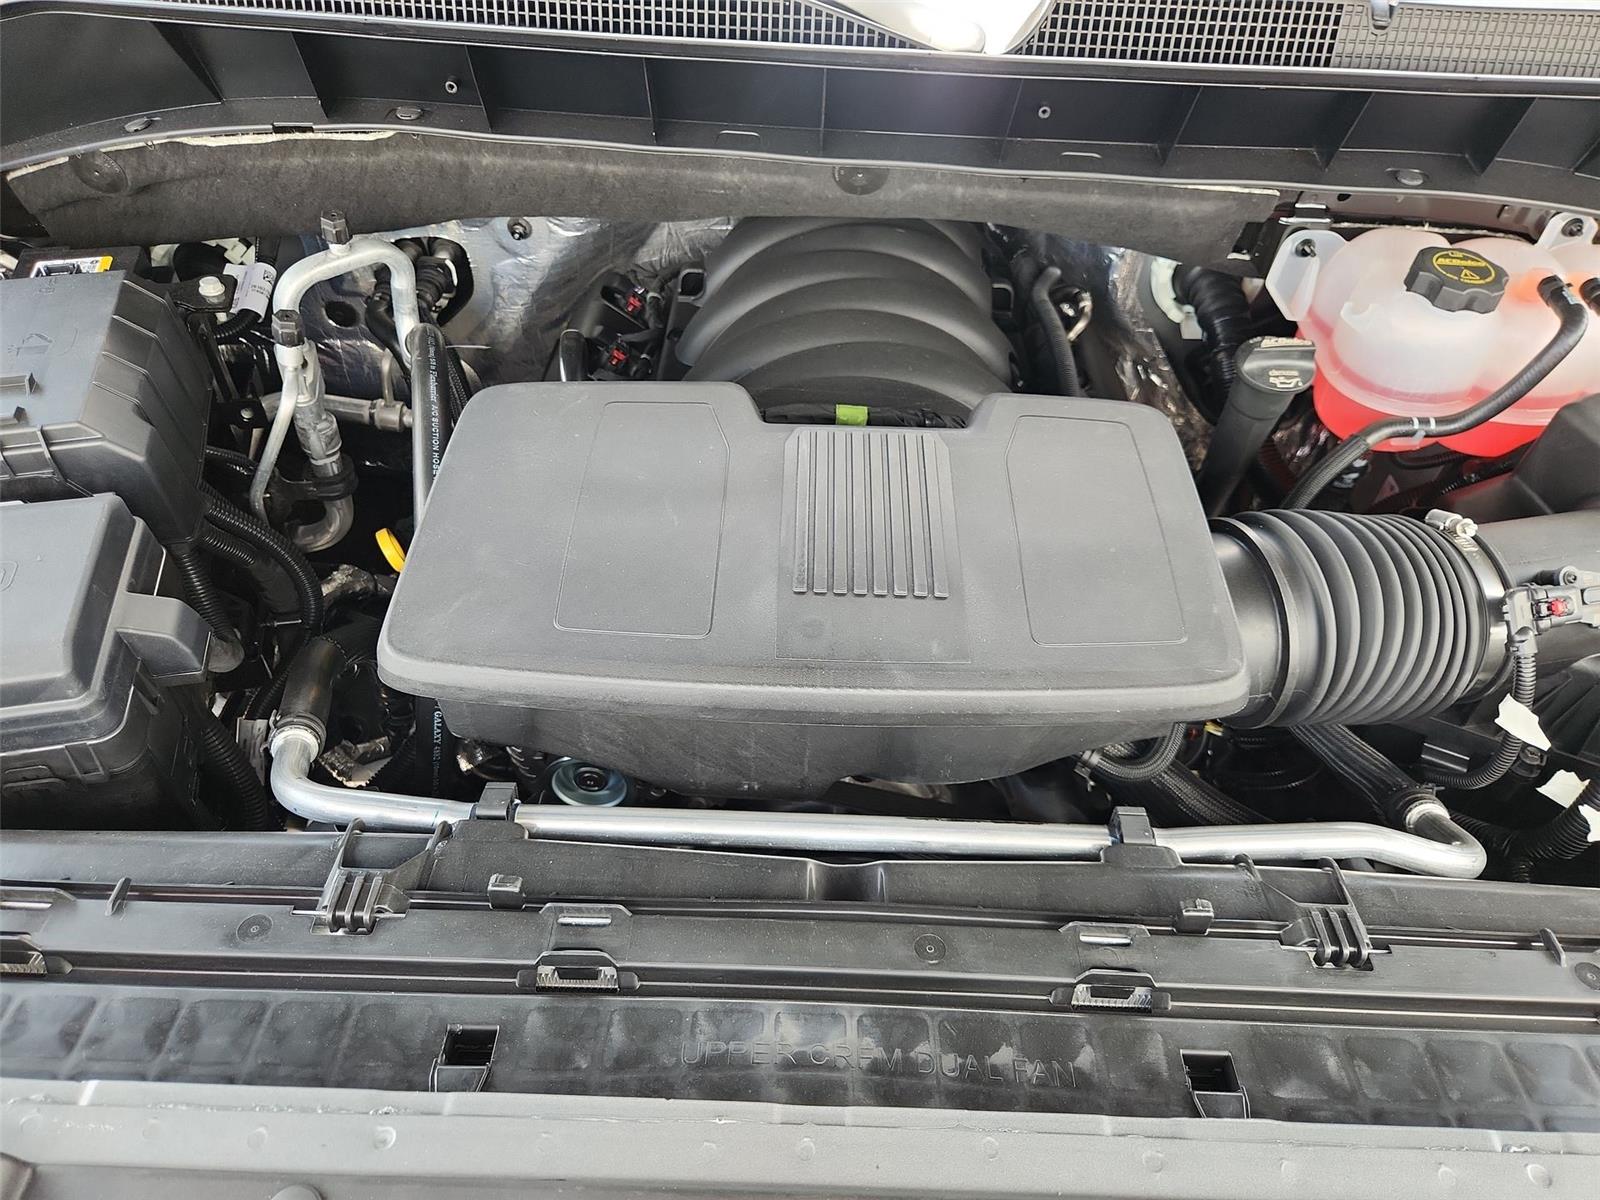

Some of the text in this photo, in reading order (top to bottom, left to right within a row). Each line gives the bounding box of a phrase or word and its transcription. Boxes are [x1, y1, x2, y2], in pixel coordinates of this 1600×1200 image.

[432, 417, 440, 450] SUCTION
[434, 711, 443, 744] GALAXY
[681, 1041, 797, 1065] UPPER
[917, 1052, 1003, 1082] DUAL
[1012, 1057, 1077, 1088] FAN
